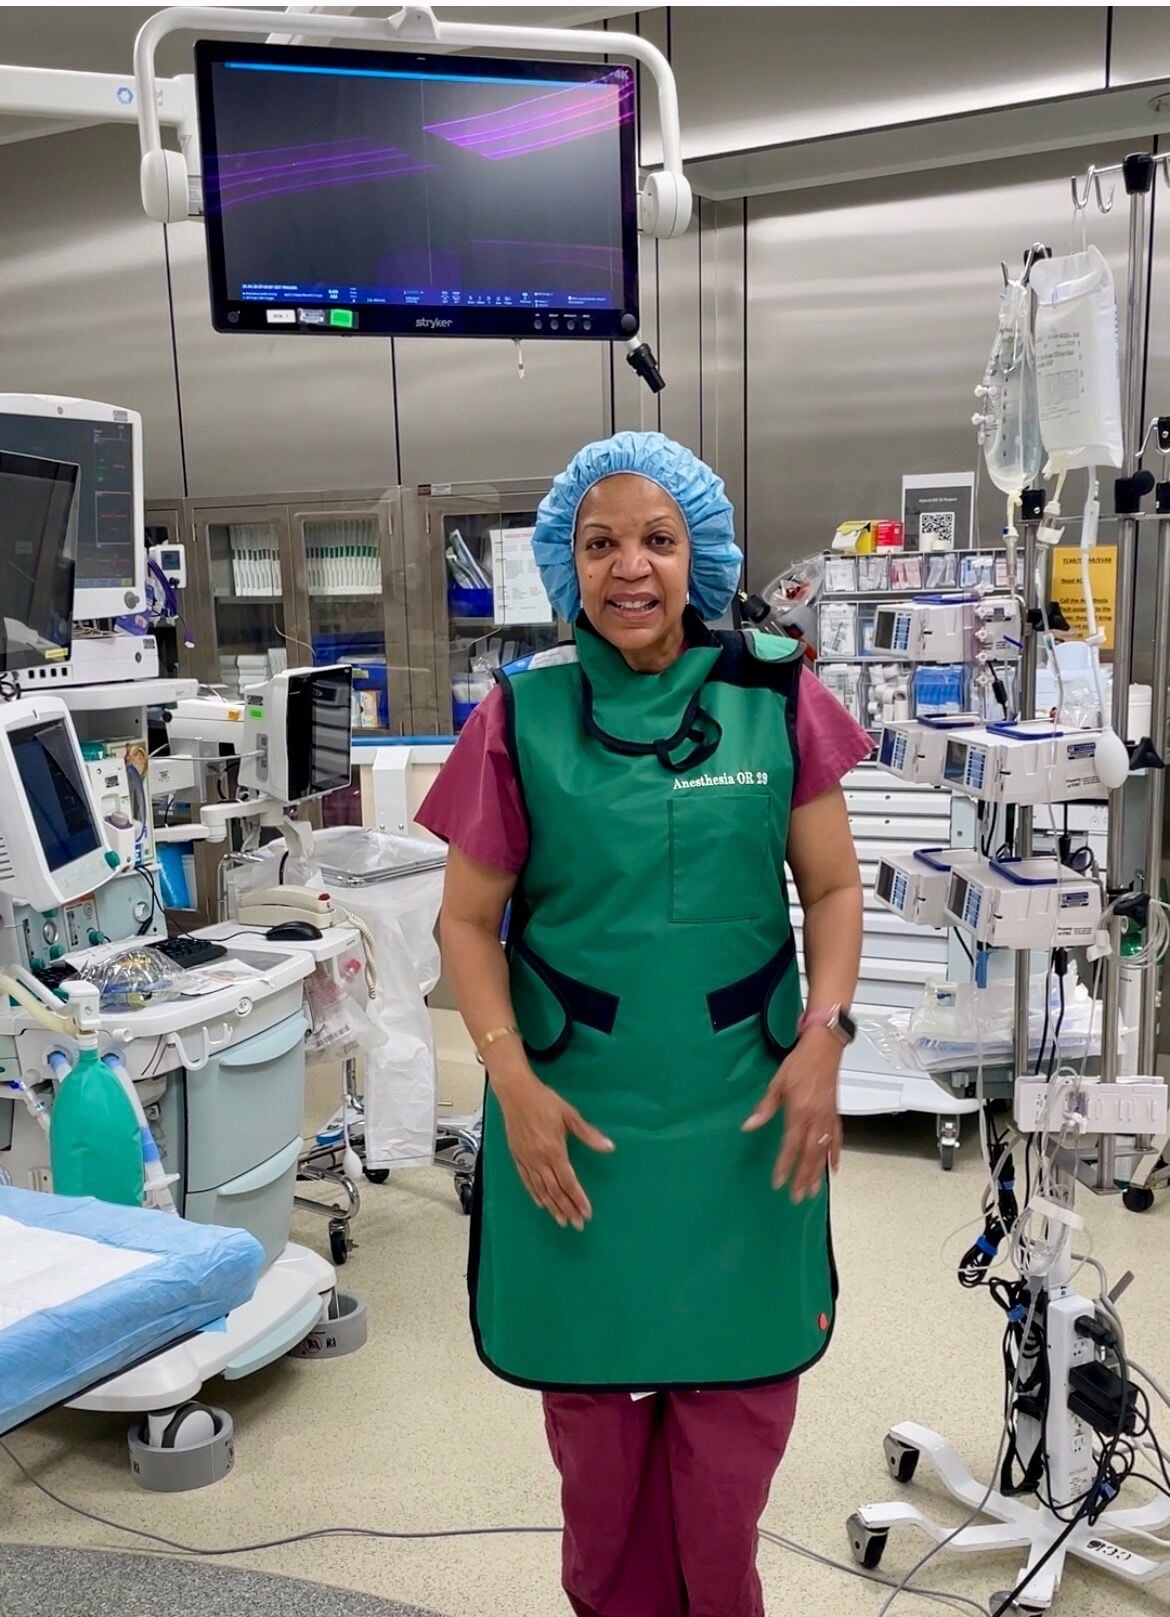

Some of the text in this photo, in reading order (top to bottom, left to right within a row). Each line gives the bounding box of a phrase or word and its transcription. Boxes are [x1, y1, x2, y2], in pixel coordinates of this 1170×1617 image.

[416, 317, 453, 329] stryker
[673, 772, 736, 790] Anesthesia
[736, 771, 754, 785] OR
